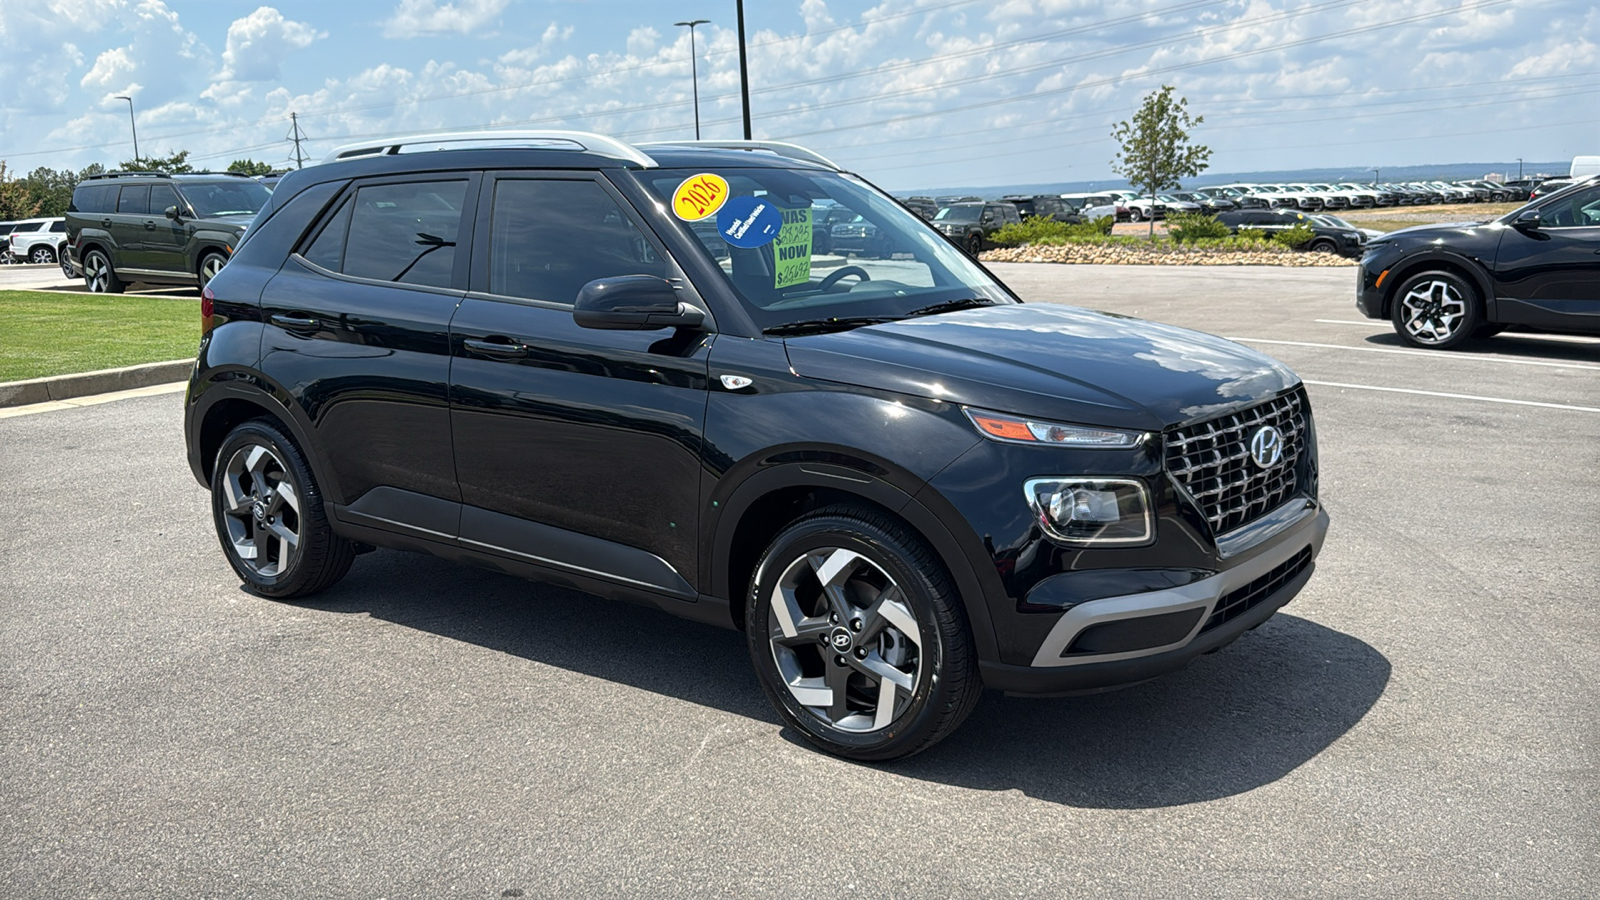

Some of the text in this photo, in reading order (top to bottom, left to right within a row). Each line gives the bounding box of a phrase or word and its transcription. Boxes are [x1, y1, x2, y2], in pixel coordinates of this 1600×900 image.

[681, 176, 721, 216] 2026
[725, 218, 743, 236] Hyundai
[779, 244, 808, 261] NOW
